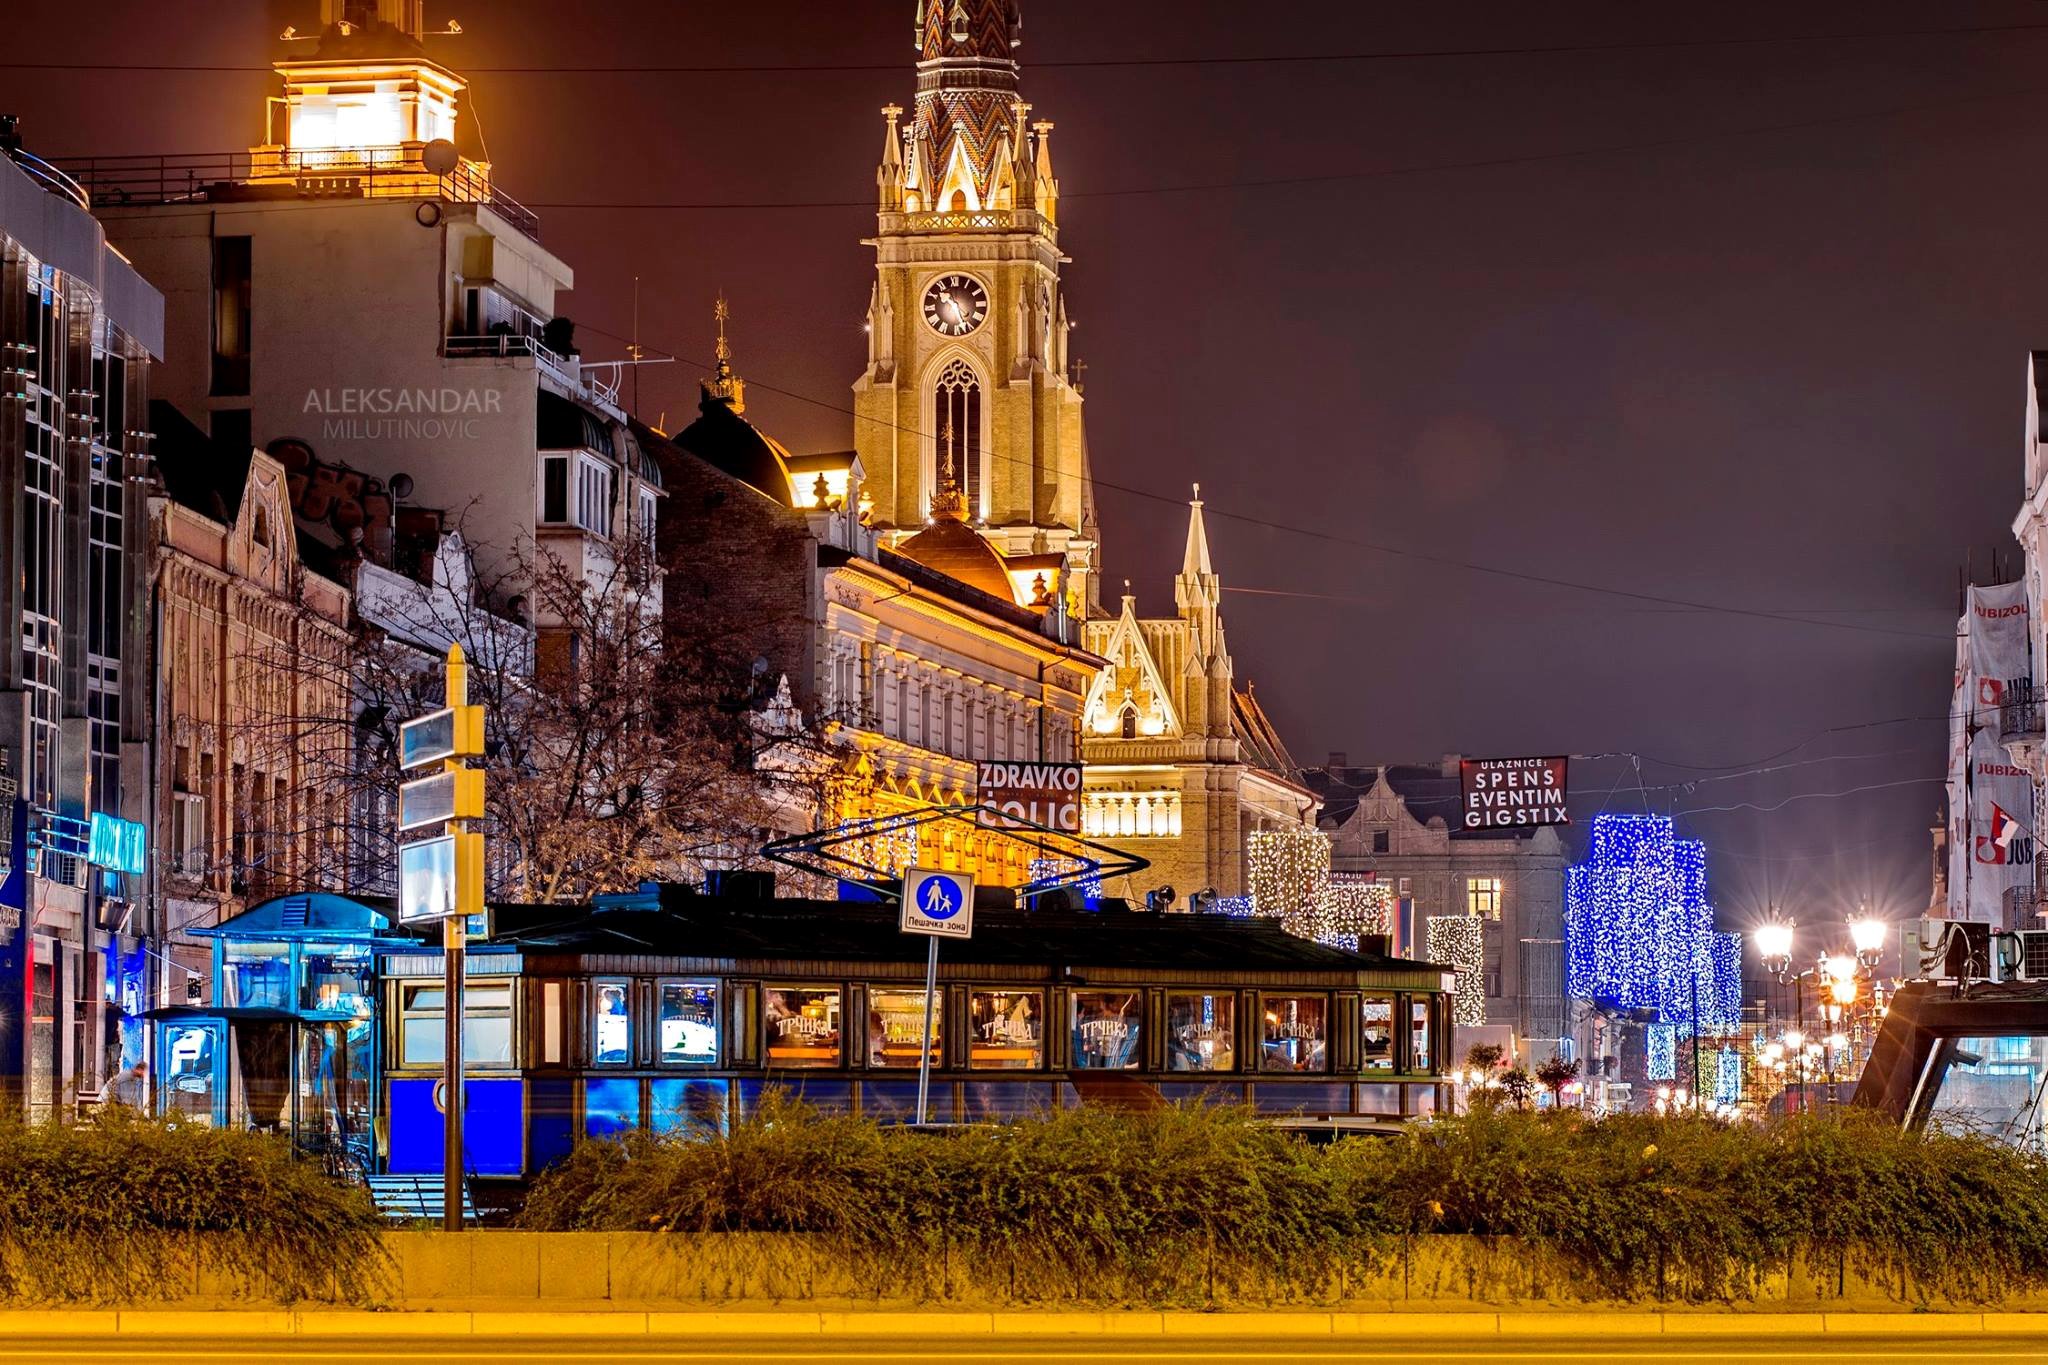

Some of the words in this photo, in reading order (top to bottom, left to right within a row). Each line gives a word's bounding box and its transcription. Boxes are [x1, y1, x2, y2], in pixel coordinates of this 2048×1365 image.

[1480, 759, 1547, 770] ULAZNICE:
[1977, 763, 2030, 776] JUBIZO
[979, 763, 1080, 791] ZDRAVKO
[1475, 769, 1554, 789] SPENS
[1469, 788, 1562, 808] EVENTIM
[1465, 807, 1568, 827] GIGSTIX
[908, 916, 944, 928] Пешачка
[947, 922, 966, 931] зона
[1081, 1020, 1128, 1039] ТРЧИКА
